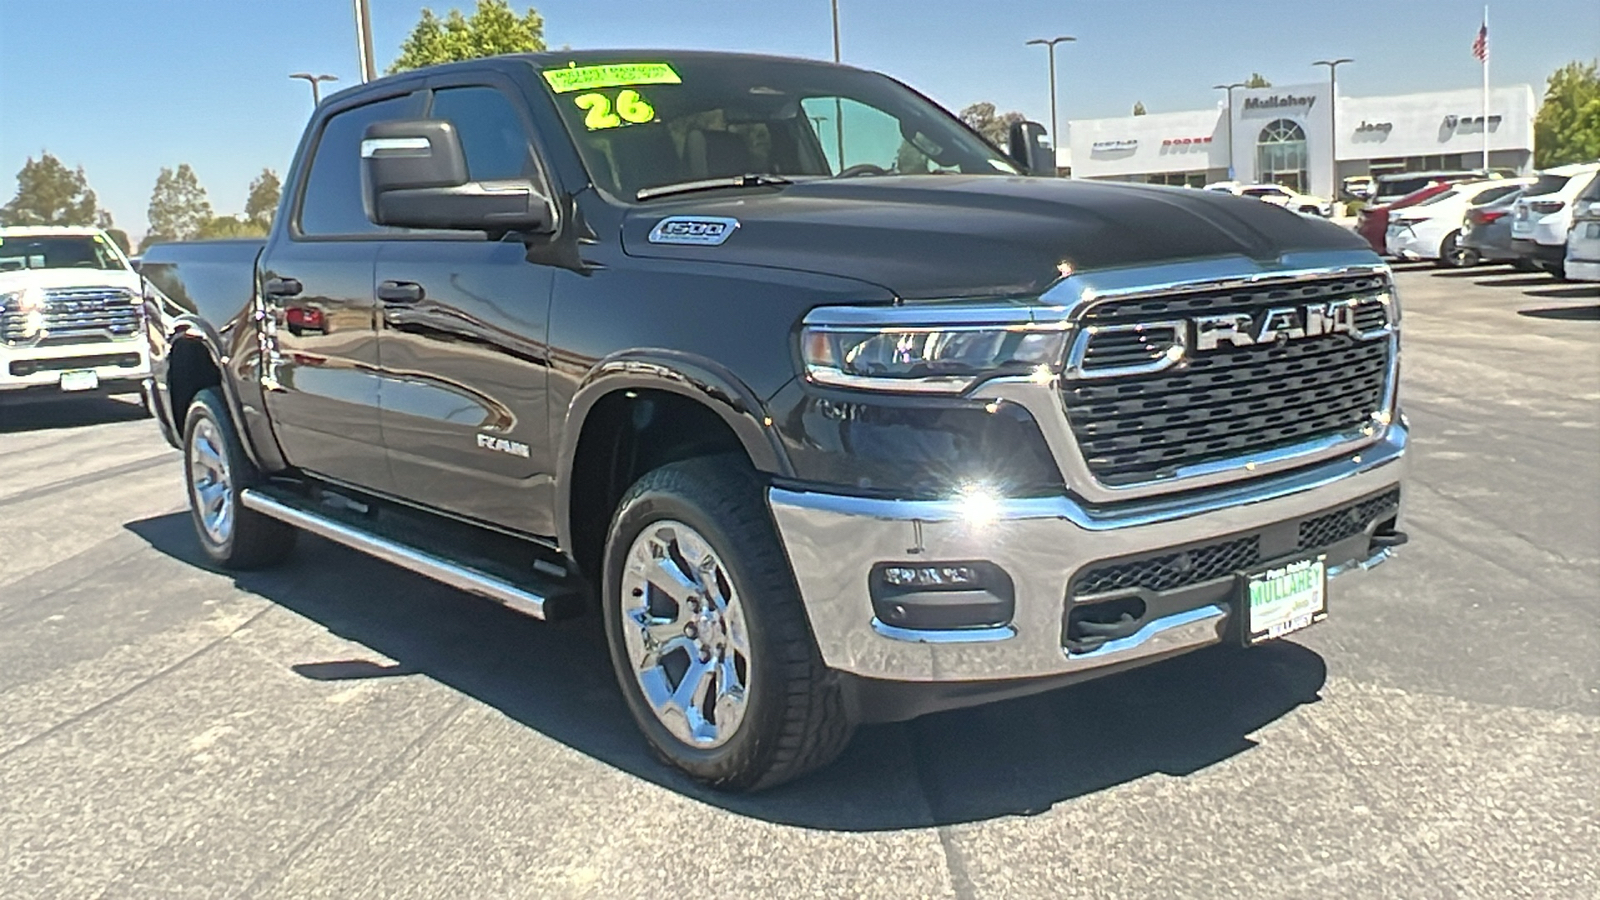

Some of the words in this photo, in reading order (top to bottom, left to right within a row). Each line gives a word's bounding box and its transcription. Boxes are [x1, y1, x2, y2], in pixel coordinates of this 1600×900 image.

[575, 89, 655, 129] 26
[1245, 94, 1316, 110] Mullahey
[1355, 120, 1393, 134] Jeep
[662, 221, 725, 235] 1500
[1195, 301, 1354, 351] RAM
[476, 433, 530, 458] RAM
[1250, 568, 1320, 606] MULLAHEY
